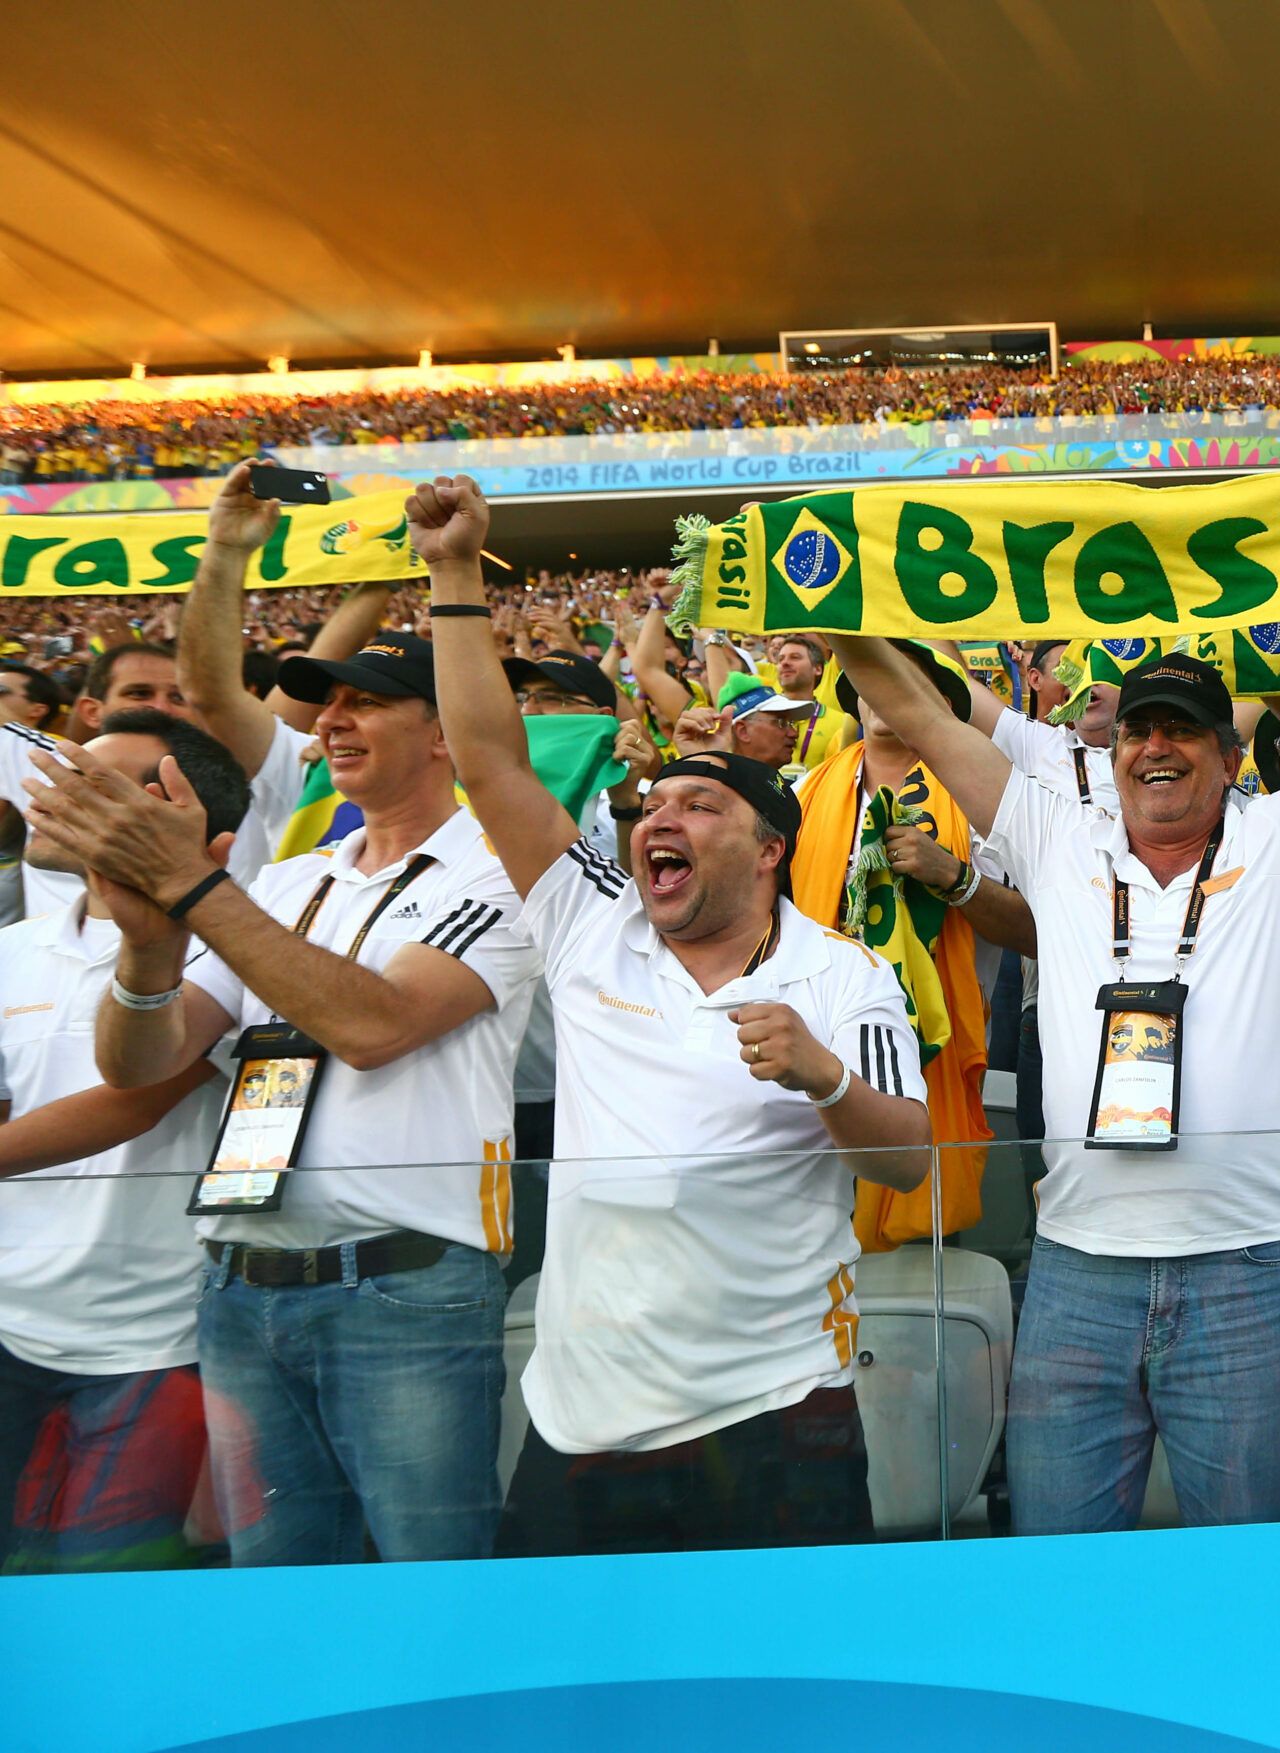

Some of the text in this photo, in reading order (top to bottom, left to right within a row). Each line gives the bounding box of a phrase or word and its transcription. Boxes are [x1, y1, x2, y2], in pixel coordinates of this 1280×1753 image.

[525, 465, 579, 488] 2014
[590, 462, 640, 485] FIFA
[650, 457, 722, 481] World
[732, 455, 778, 480] Cup
[2, 514, 292, 587] rasl
[598, 991, 657, 1017] Continental
